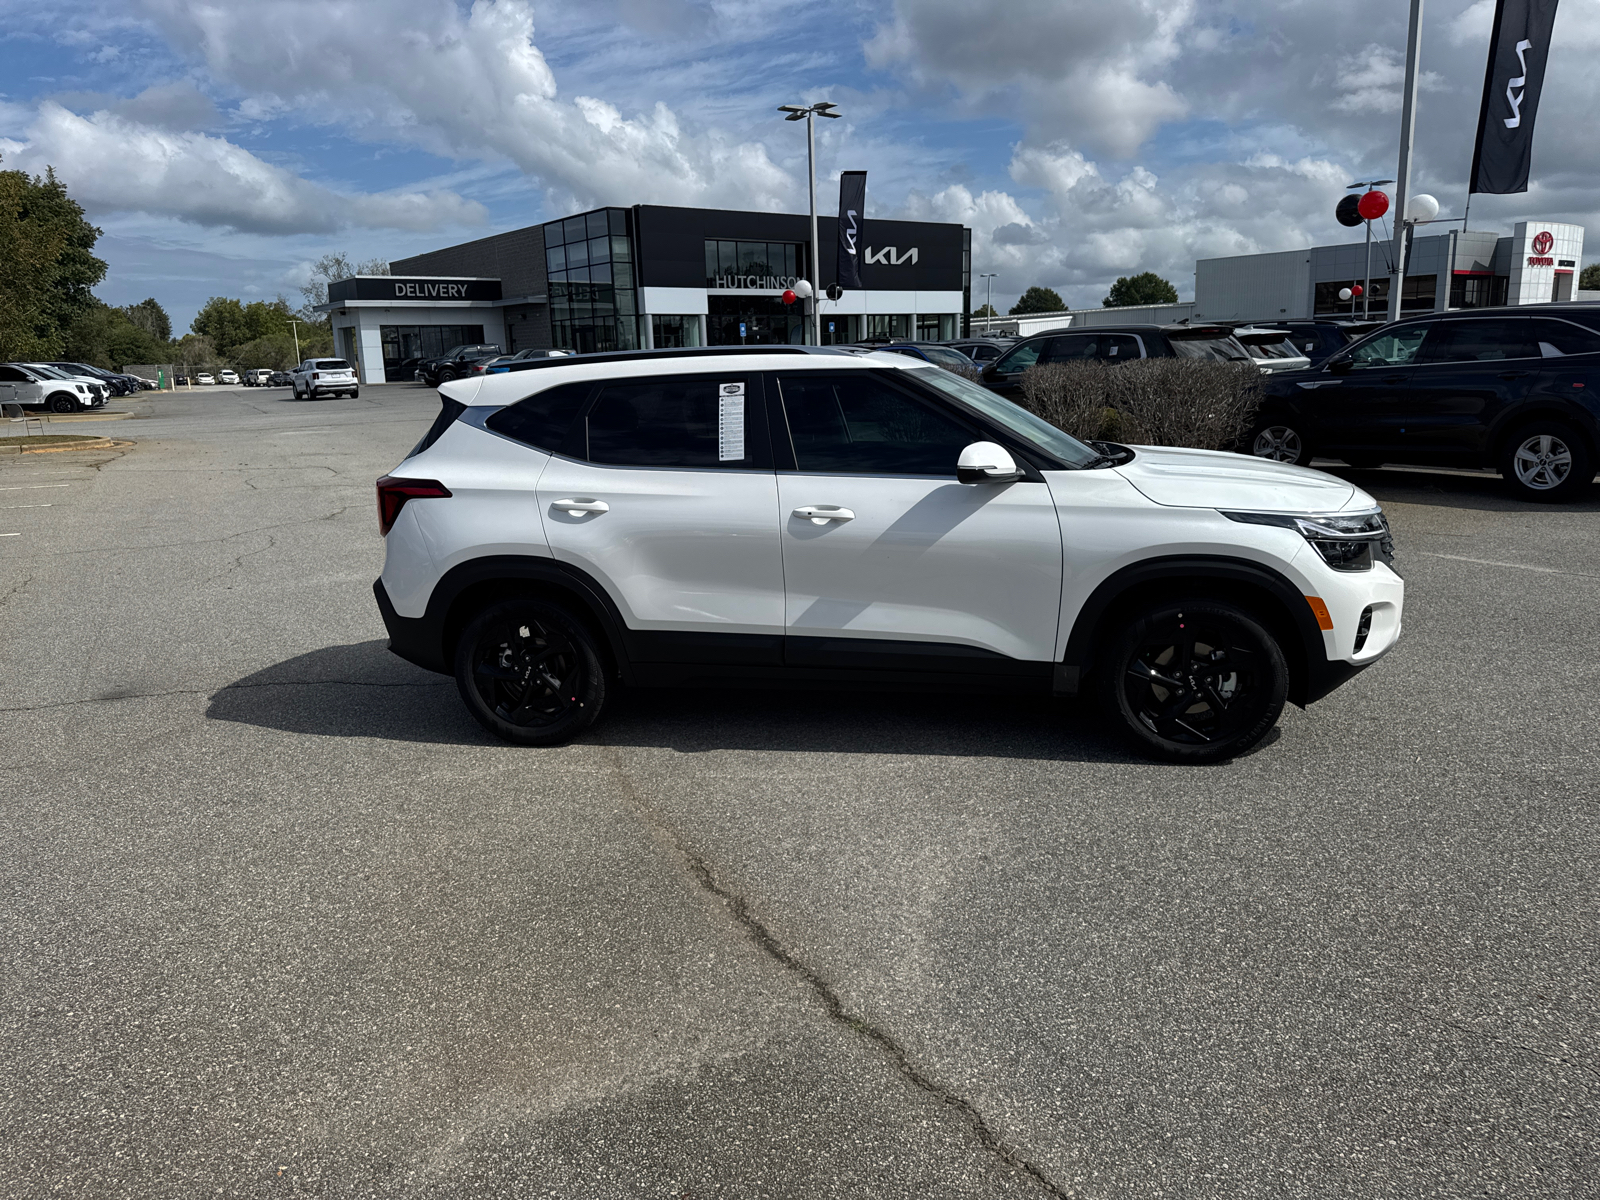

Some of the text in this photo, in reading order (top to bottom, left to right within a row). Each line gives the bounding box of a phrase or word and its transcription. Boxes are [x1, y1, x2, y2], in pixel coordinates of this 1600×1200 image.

[865, 246, 918, 265] KIA
[1530, 257, 1553, 266] TOYOTA
[395, 283, 467, 297] DELIVERY
[1236, 702, 1276, 747] KUMHO
